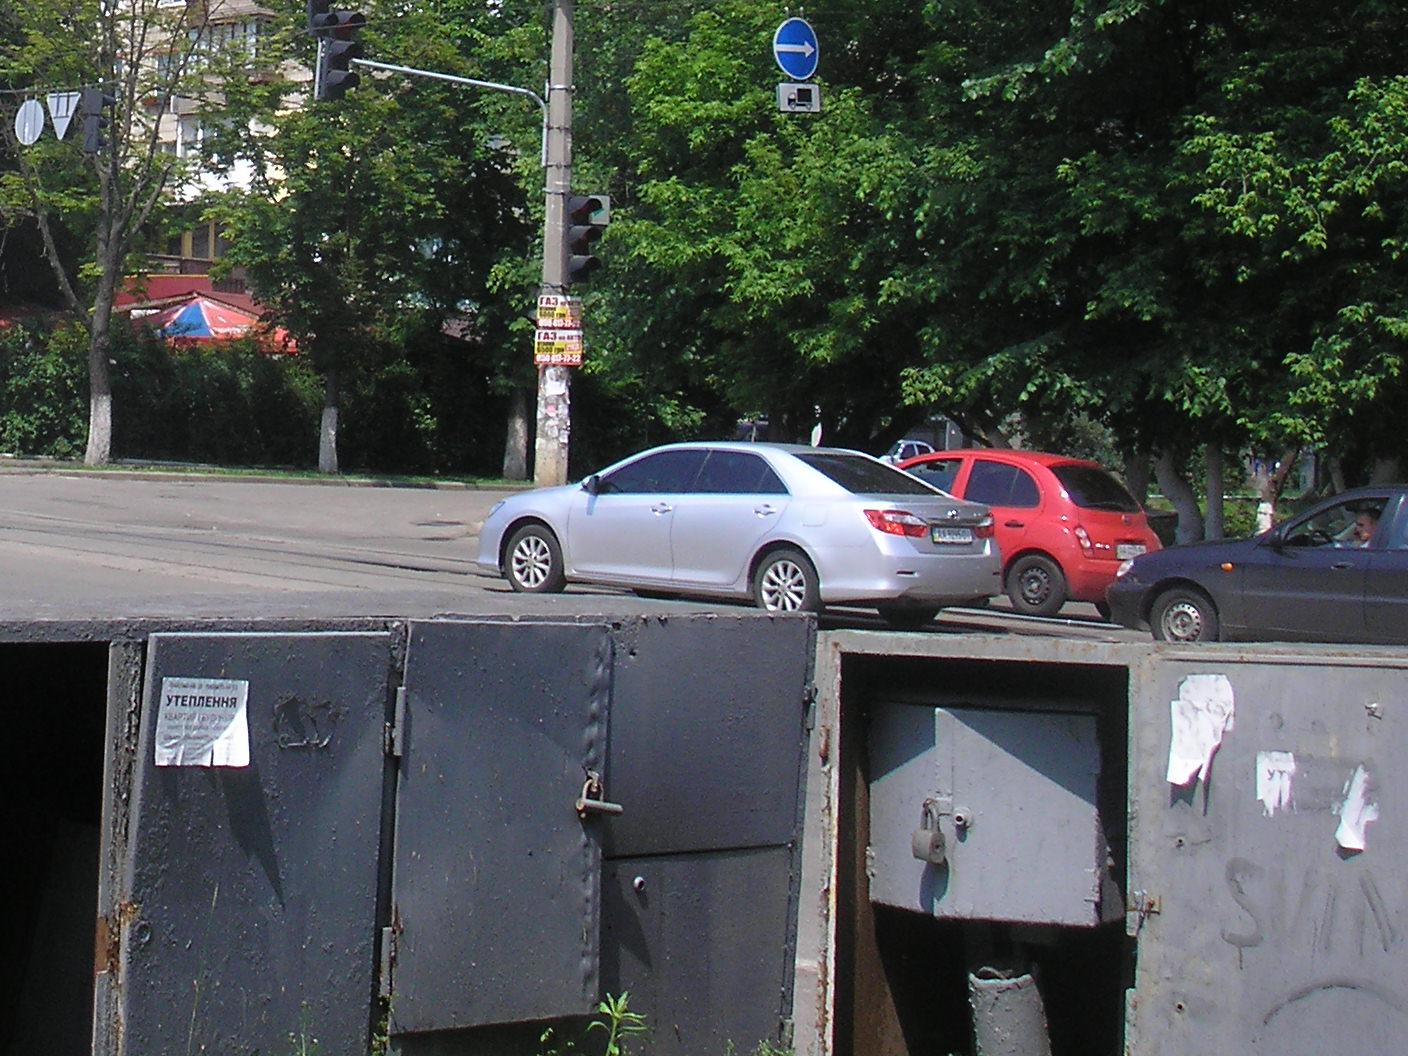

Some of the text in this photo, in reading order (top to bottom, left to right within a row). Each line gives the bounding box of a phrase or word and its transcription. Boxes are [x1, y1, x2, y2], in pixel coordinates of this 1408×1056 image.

[540, 297, 558, 305] ГАЗ
[537, 332, 557, 340] ГАЗ
[166, 694, 238, 709] УТЕПЛЕННЯ
